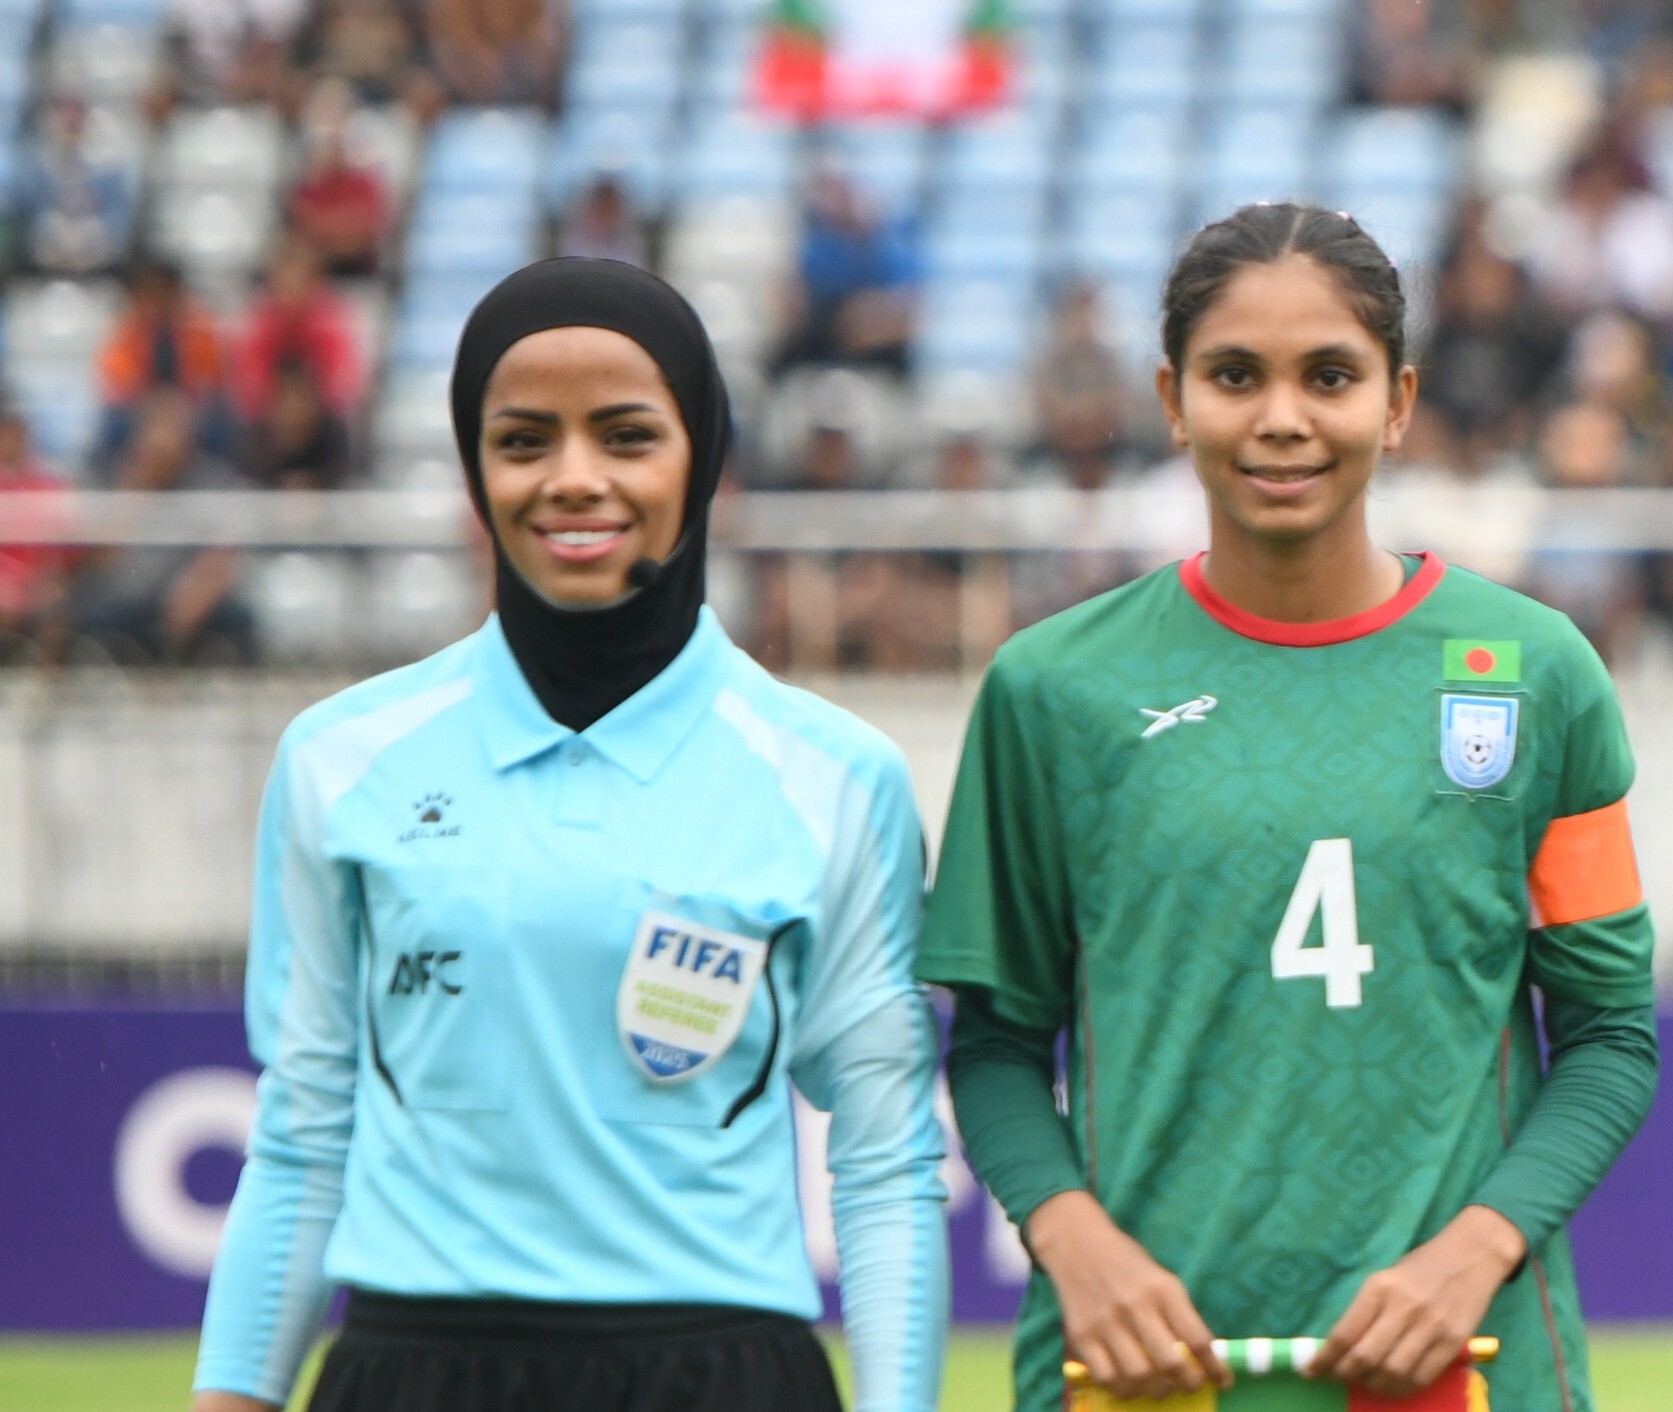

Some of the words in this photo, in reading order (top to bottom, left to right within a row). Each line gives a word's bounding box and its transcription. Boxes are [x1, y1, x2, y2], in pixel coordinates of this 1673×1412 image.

[1271, 838, 1375, 1009] 4
[387, 950, 464, 996] AFC
[645, 924, 743, 985] FIFA
